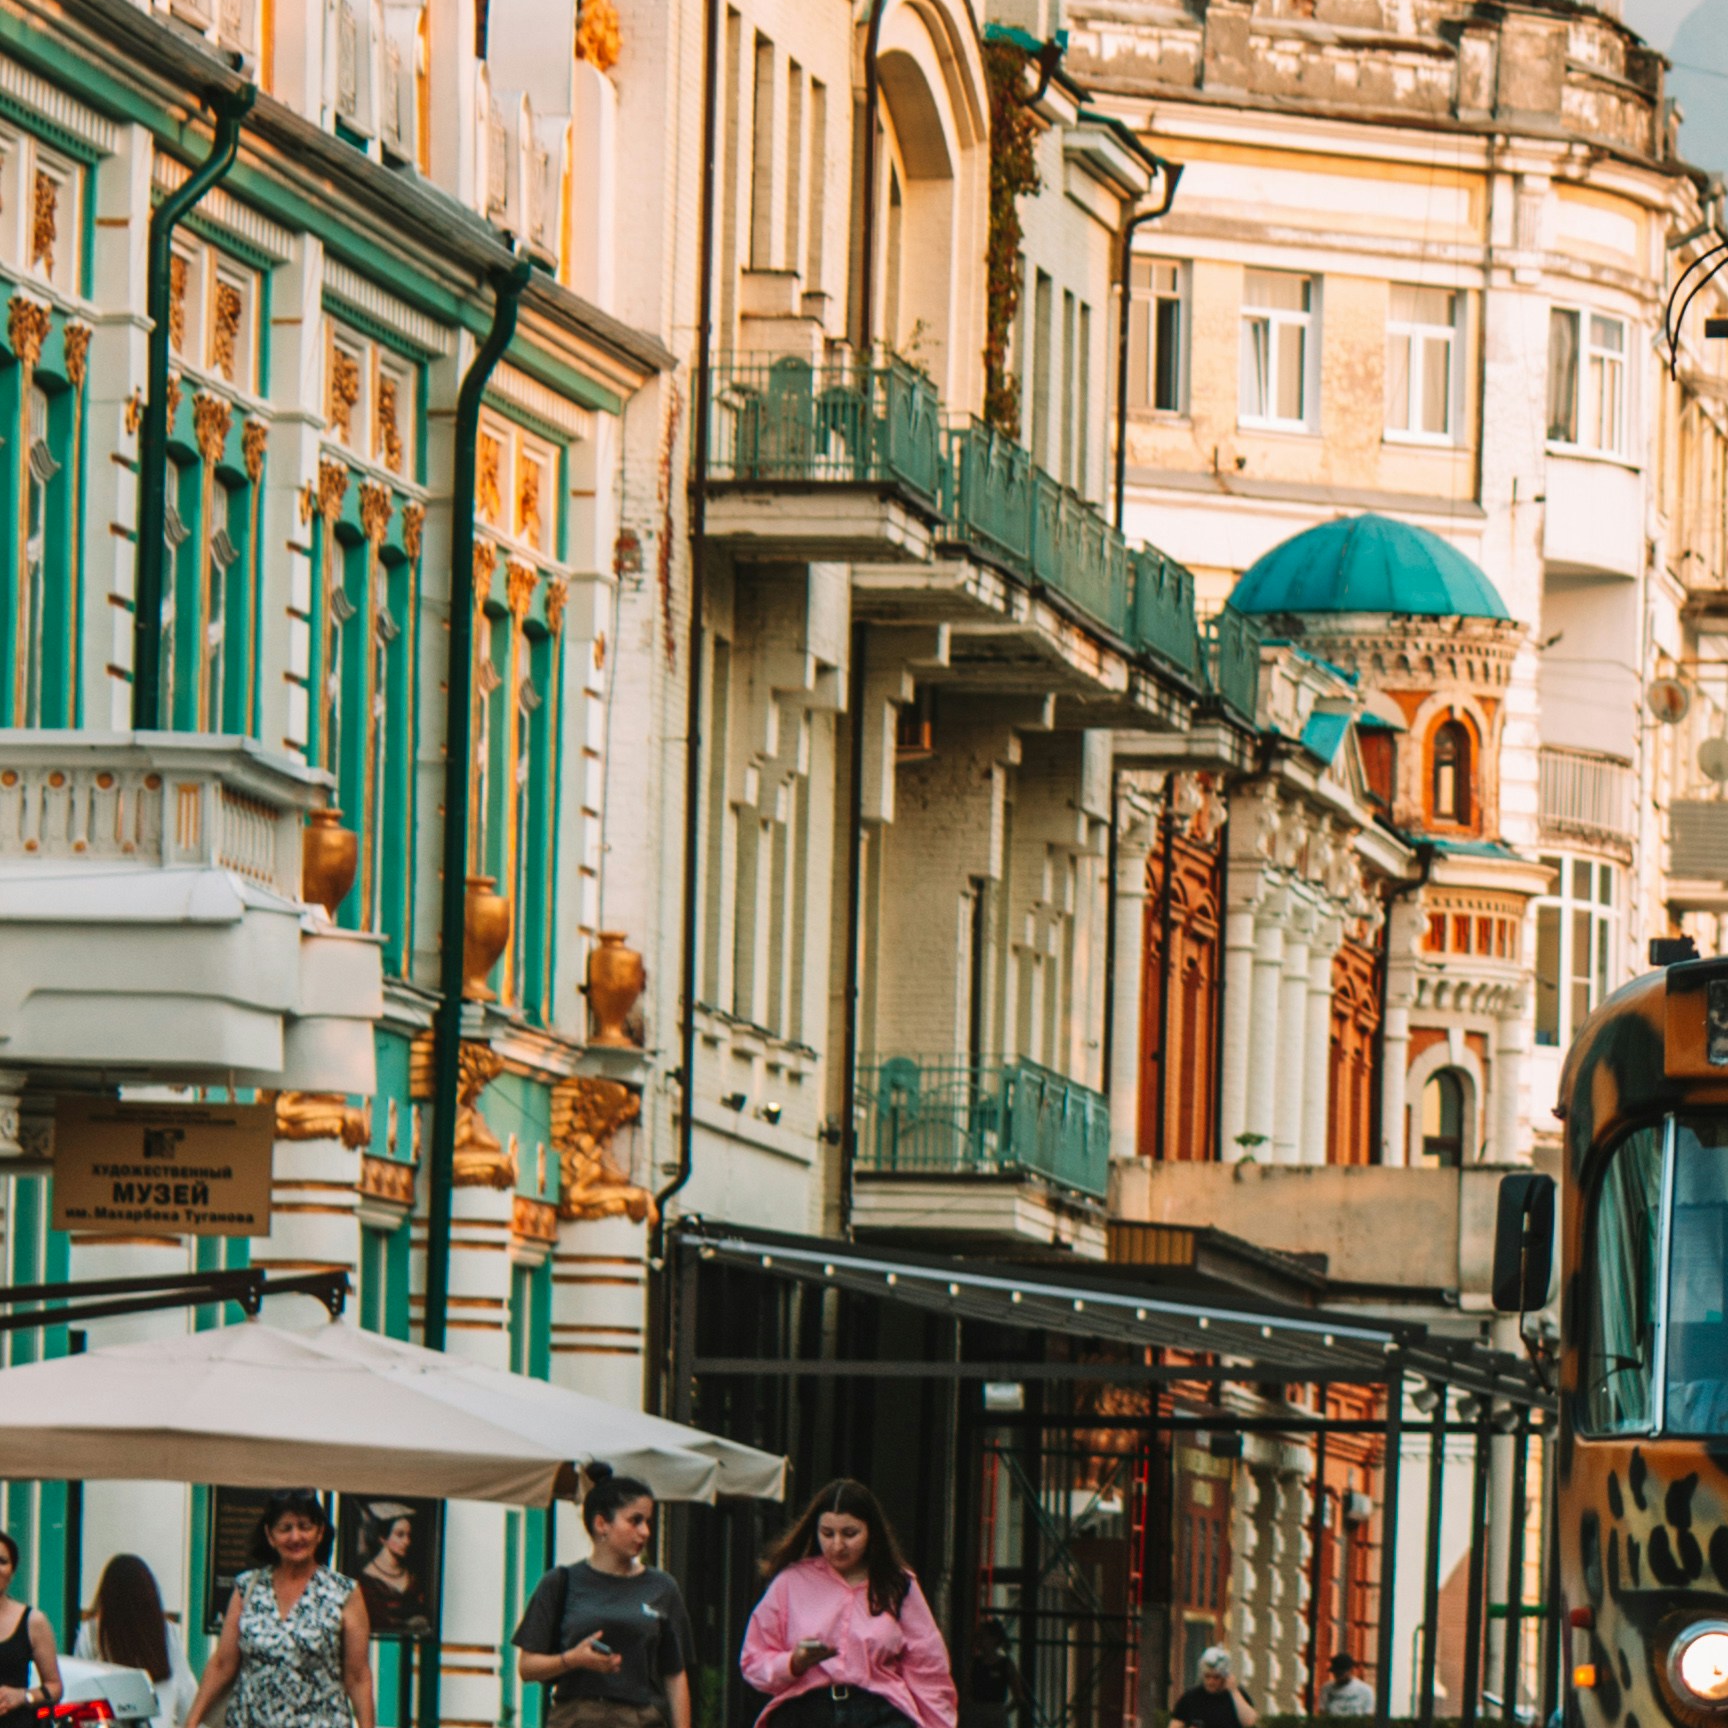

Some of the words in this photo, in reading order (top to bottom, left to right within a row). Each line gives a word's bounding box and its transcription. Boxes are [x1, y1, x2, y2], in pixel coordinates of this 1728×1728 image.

[92, 1164, 233, 1179] ХУДОЖЕСТВЕННЫЙ
[112, 1180, 209, 1206] МУЗЕЙ
[65, 1208, 91, 1219] им.
[185, 1209, 255, 1225] Туганова
